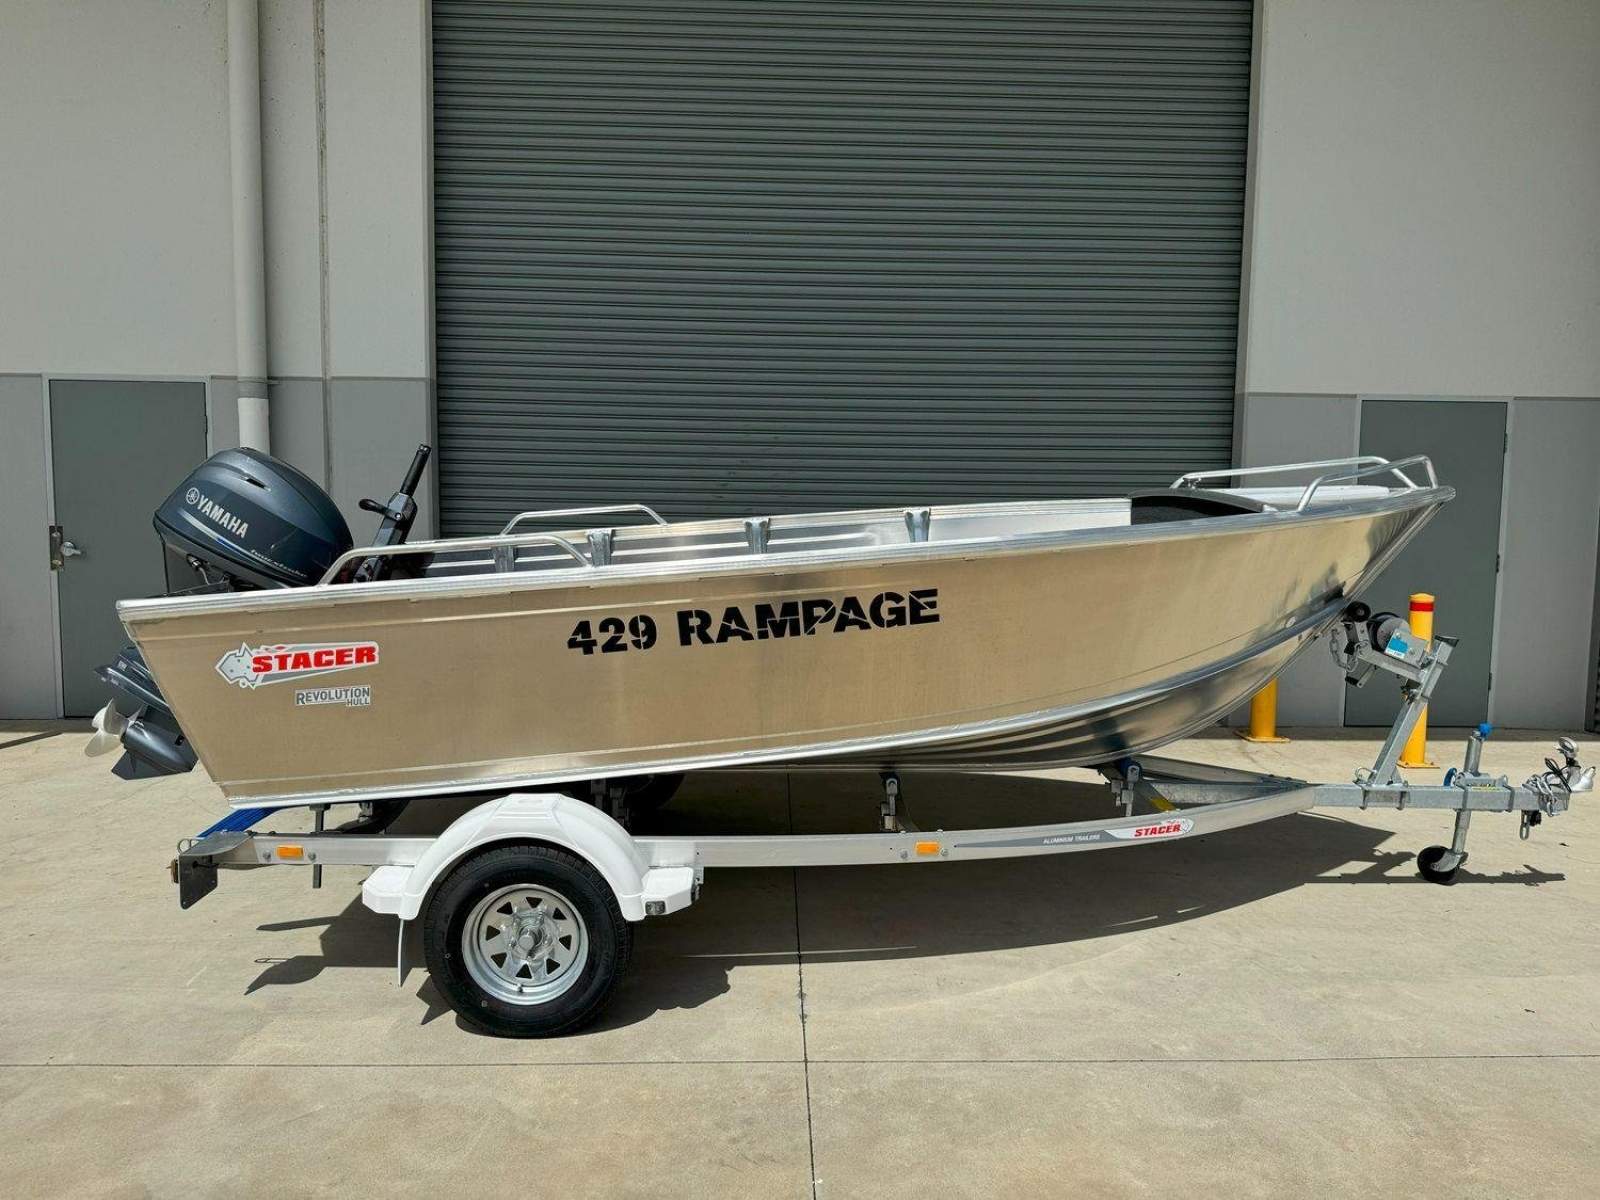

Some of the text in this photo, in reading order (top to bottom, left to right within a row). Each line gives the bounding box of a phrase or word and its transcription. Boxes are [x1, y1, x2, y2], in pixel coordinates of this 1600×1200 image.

[198, 494, 249, 538] YAMAHA
[567, 588, 940, 655] 429 RAMPAGE
[252, 646, 376, 673] STACER
[296, 687, 370, 705] REVOLUTION
[347, 698, 370, 706] HULL
[1134, 823, 1181, 837] STACER
